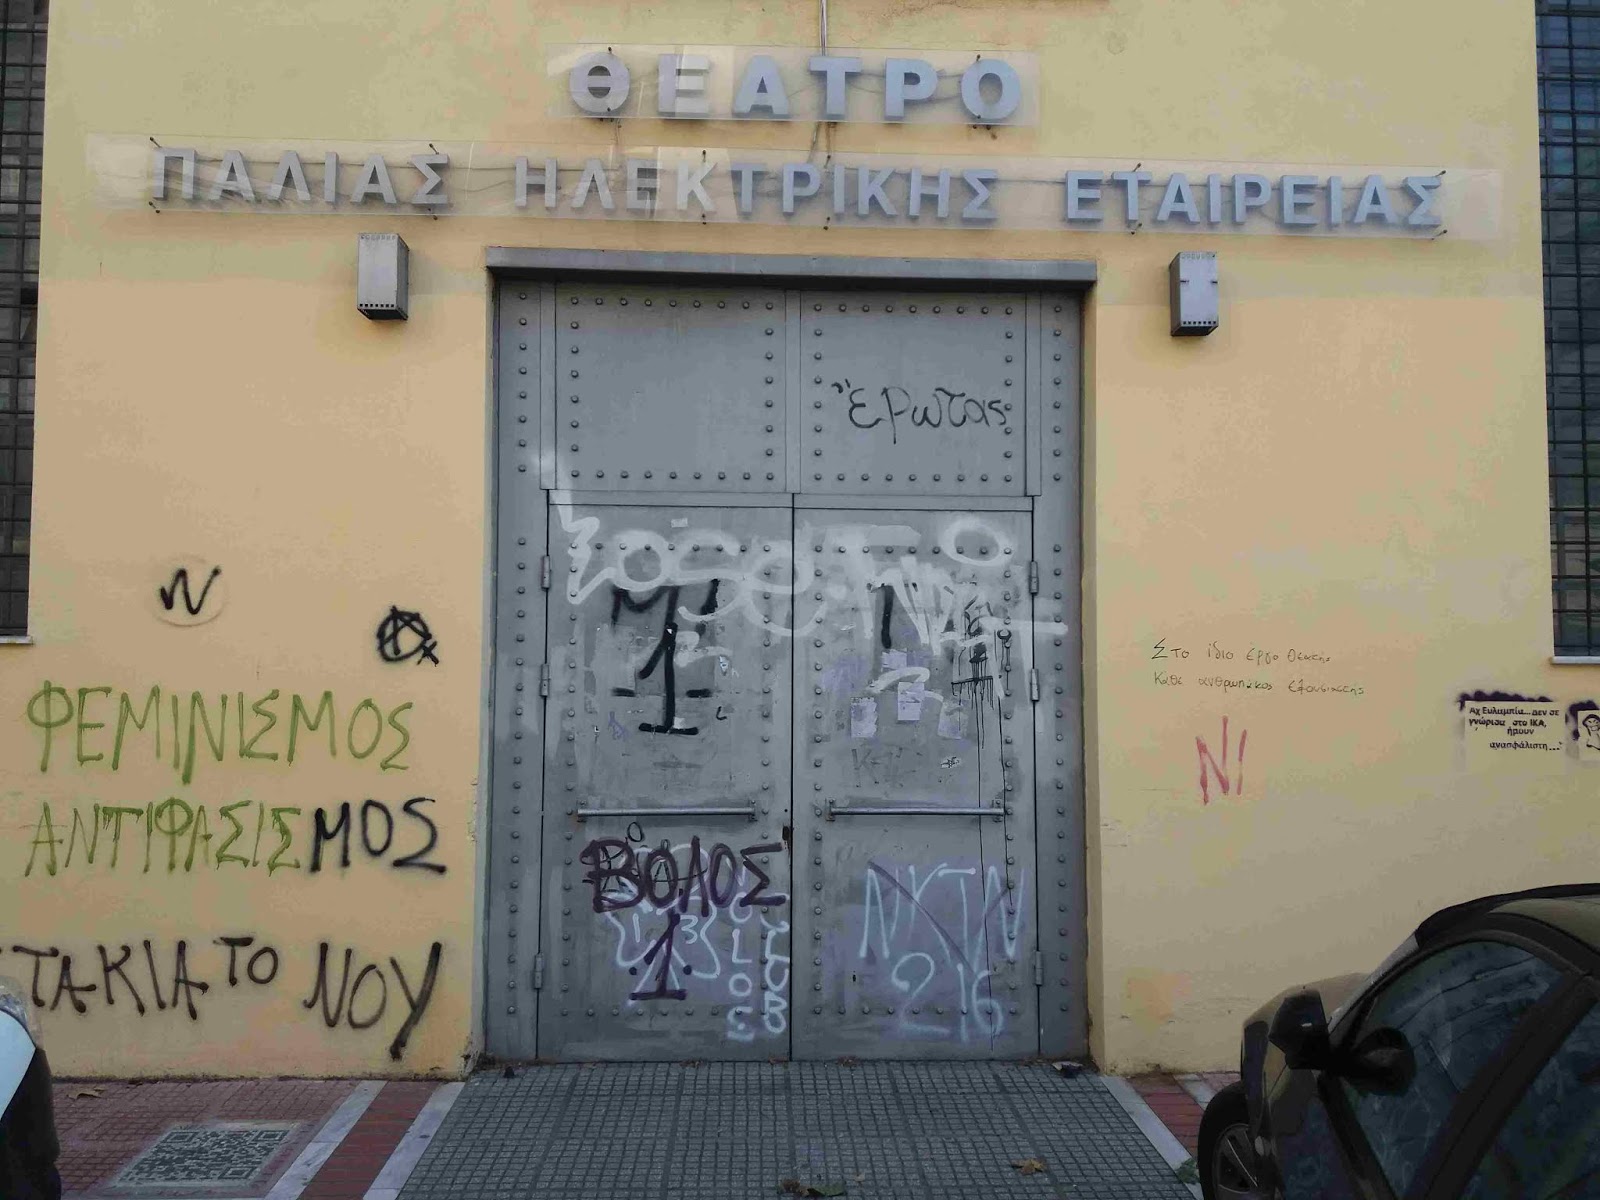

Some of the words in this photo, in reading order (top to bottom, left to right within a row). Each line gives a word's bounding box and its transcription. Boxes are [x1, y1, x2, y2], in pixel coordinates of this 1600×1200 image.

[569, 51, 1022, 124] ΘΕΑΤΡΟ
[152, 146, 449, 205] ΠΑΛΙΑΣ
[514, 155, 1000, 220] ΗΛΕΚΤΡΙΚΗΣ
[1065, 169, 1443, 227] ΕΤΑΙΡΕΙΑΣ
[27, 680, 413, 784] ΦΕΜΙΝΙΣΜΟΣ
[25, 797, 446, 876] ΑΝΤΙΦΑΣΙΣΜΟΣ
[0, 939, 209, 1020] ΤΑΚΙΑ
